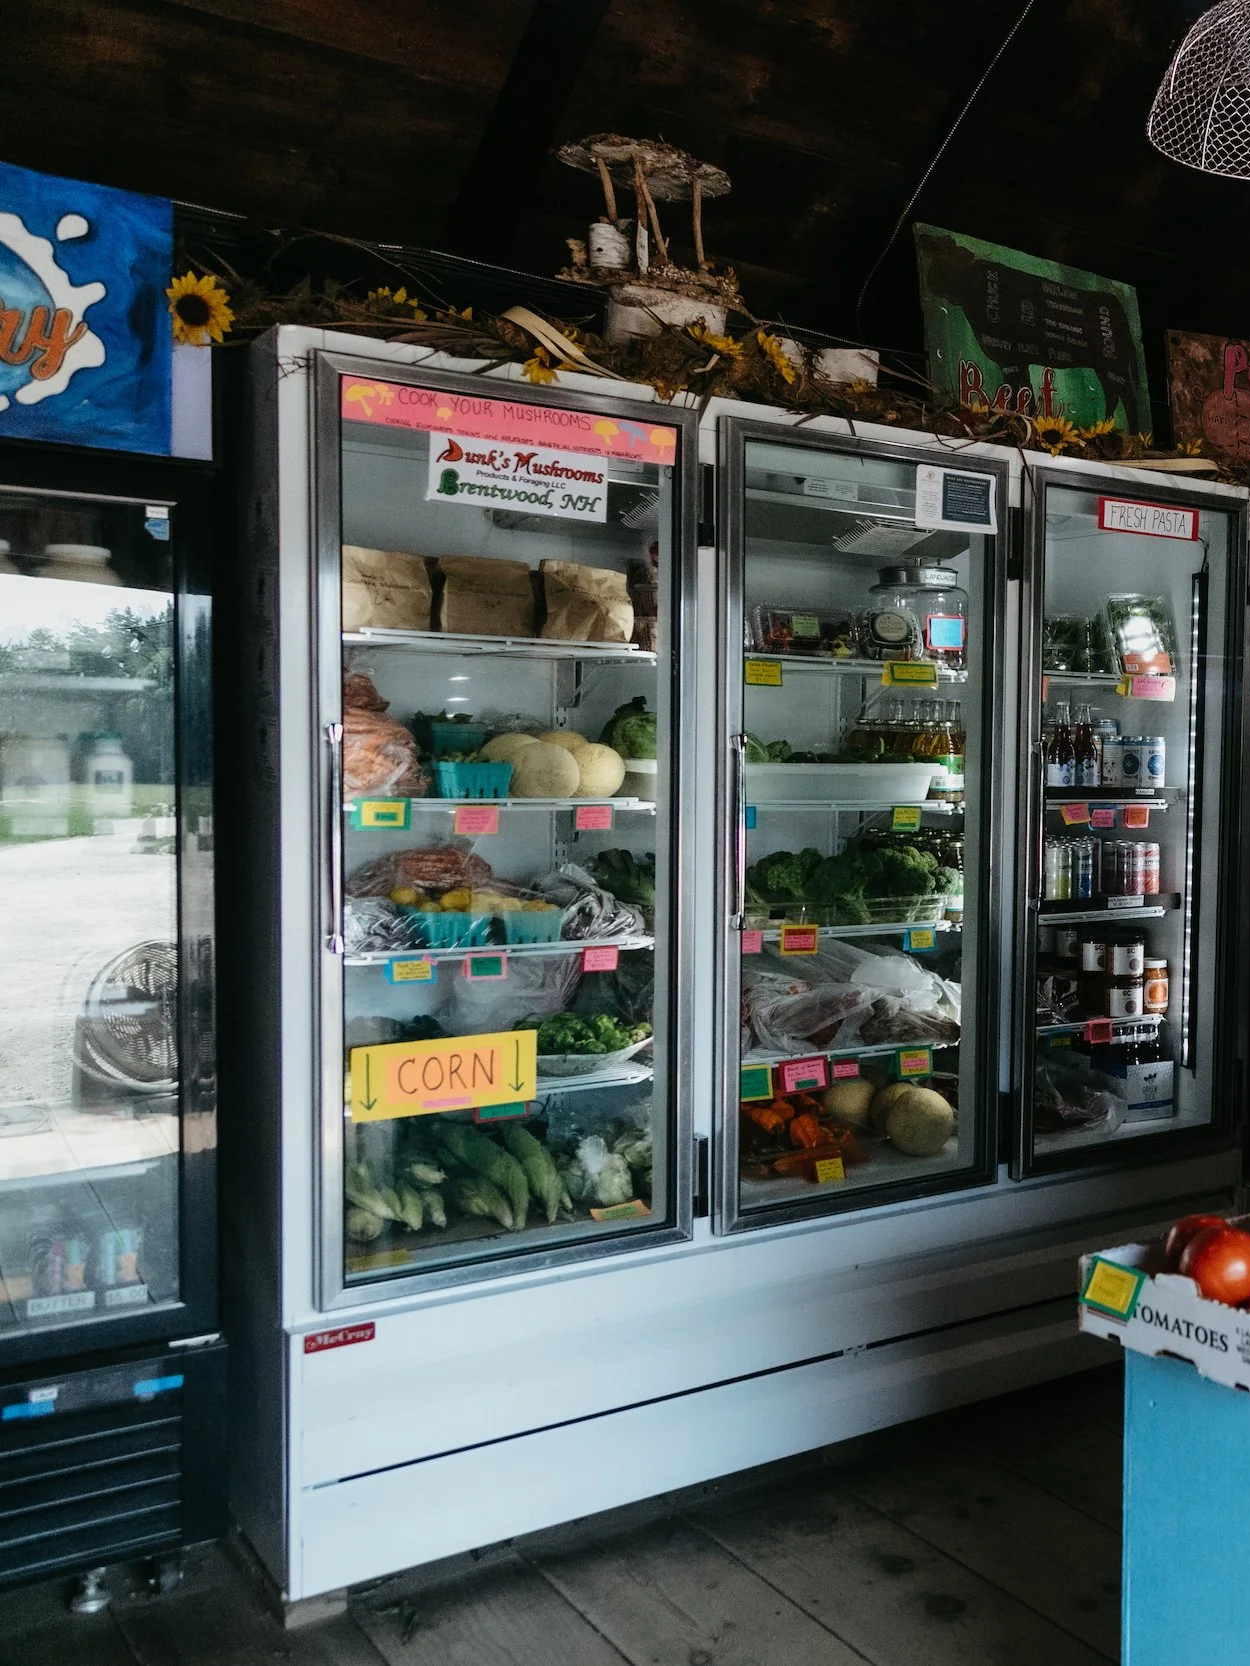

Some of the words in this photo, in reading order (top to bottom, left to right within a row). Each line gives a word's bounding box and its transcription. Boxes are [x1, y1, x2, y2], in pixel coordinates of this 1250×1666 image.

[1098, 305, 1117, 360] ROUND
[398, 387, 438, 408] COOK
[449, 395, 493, 418] YOUR
[502, 405, 592, 431] MUSHROOMS
[959, 359, 1062, 419] Beef
[436, 438, 511, 472] Dunk's
[513, 451, 605, 485] Mushrooms
[476, 469, 510, 482] Products
[511, 474, 517, 482] &
[519, 476, 551, 490] Foraging
[551, 481, 567, 490] LLC
[436, 468, 554, 509] Brentwood,
[559, 493, 602, 513] NH
[1109, 502, 1148, 527] FRESH
[1151, 508, 1188, 534] PASTA
[398, 1050, 494, 1094] CORN
[1134, 1303, 1228, 1353] TOMATOES
